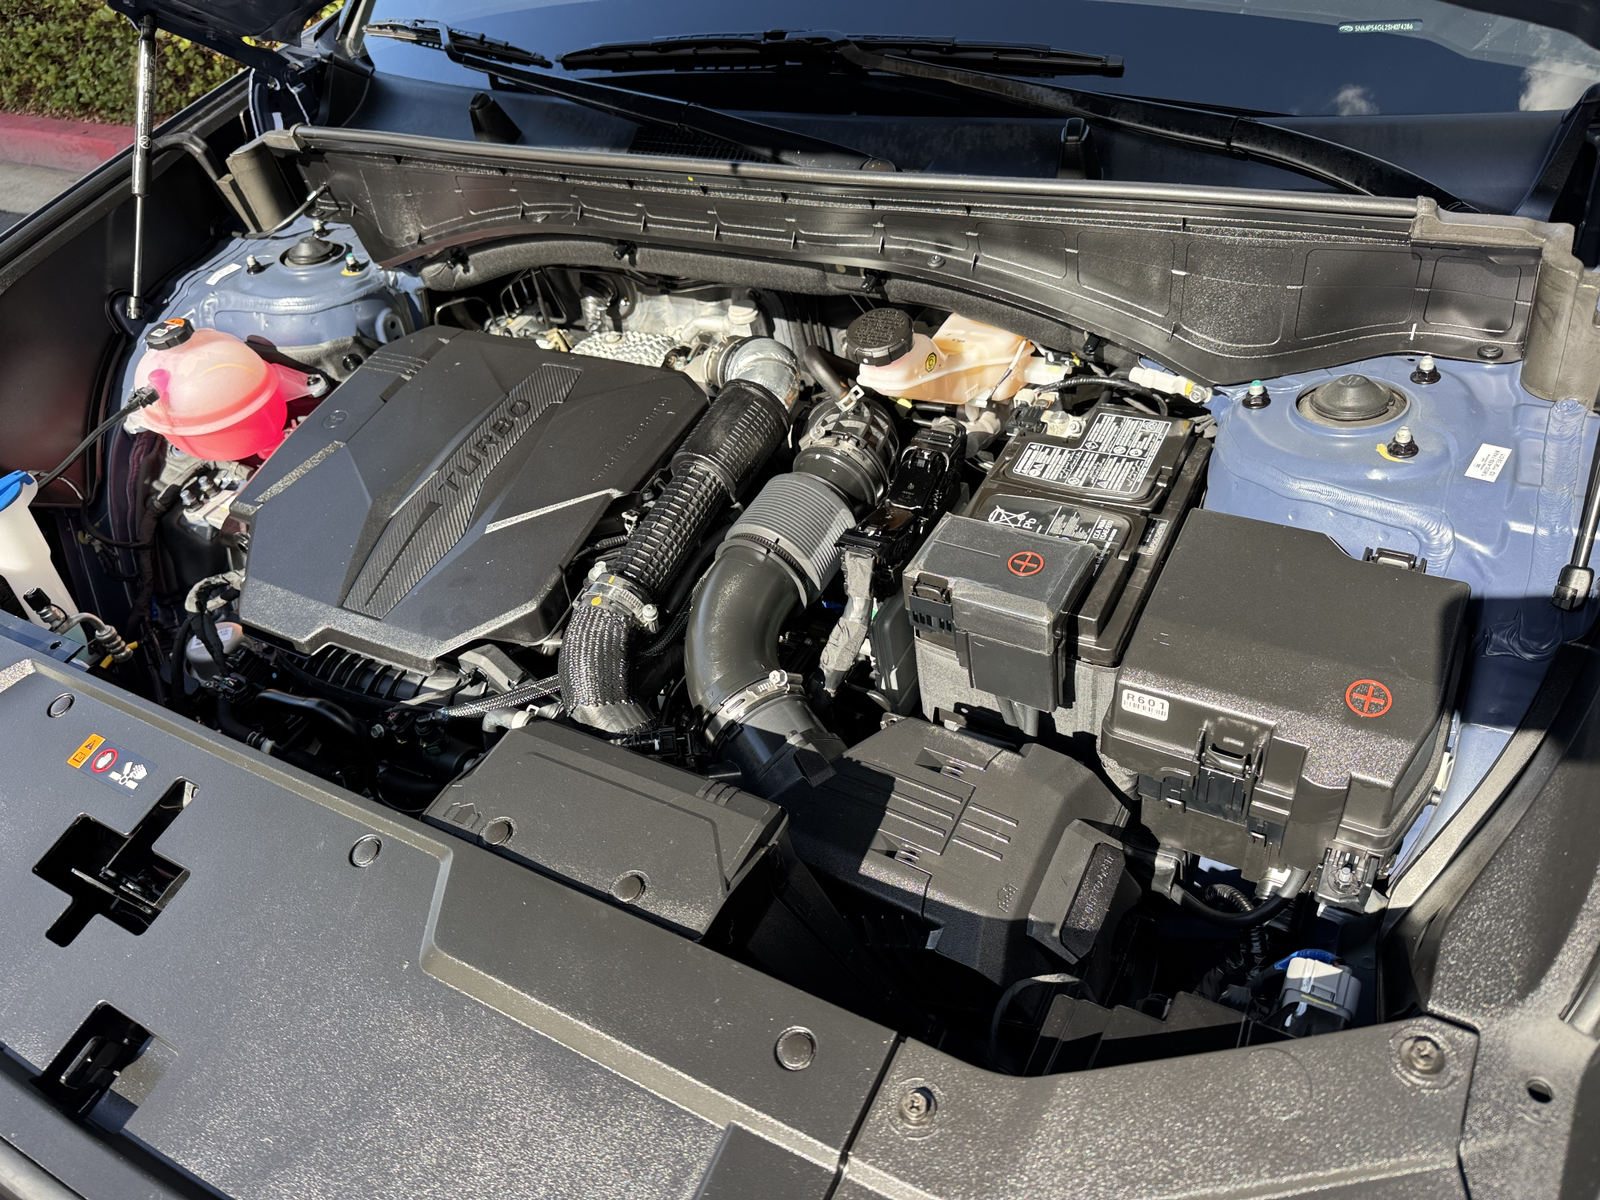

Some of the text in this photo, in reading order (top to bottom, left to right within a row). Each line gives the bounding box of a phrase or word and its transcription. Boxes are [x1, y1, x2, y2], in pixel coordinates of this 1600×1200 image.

[438, 400, 530, 492] TURBO
[1022, 517, 1037, 529] Pb
[1126, 693, 1165, 710] R601
